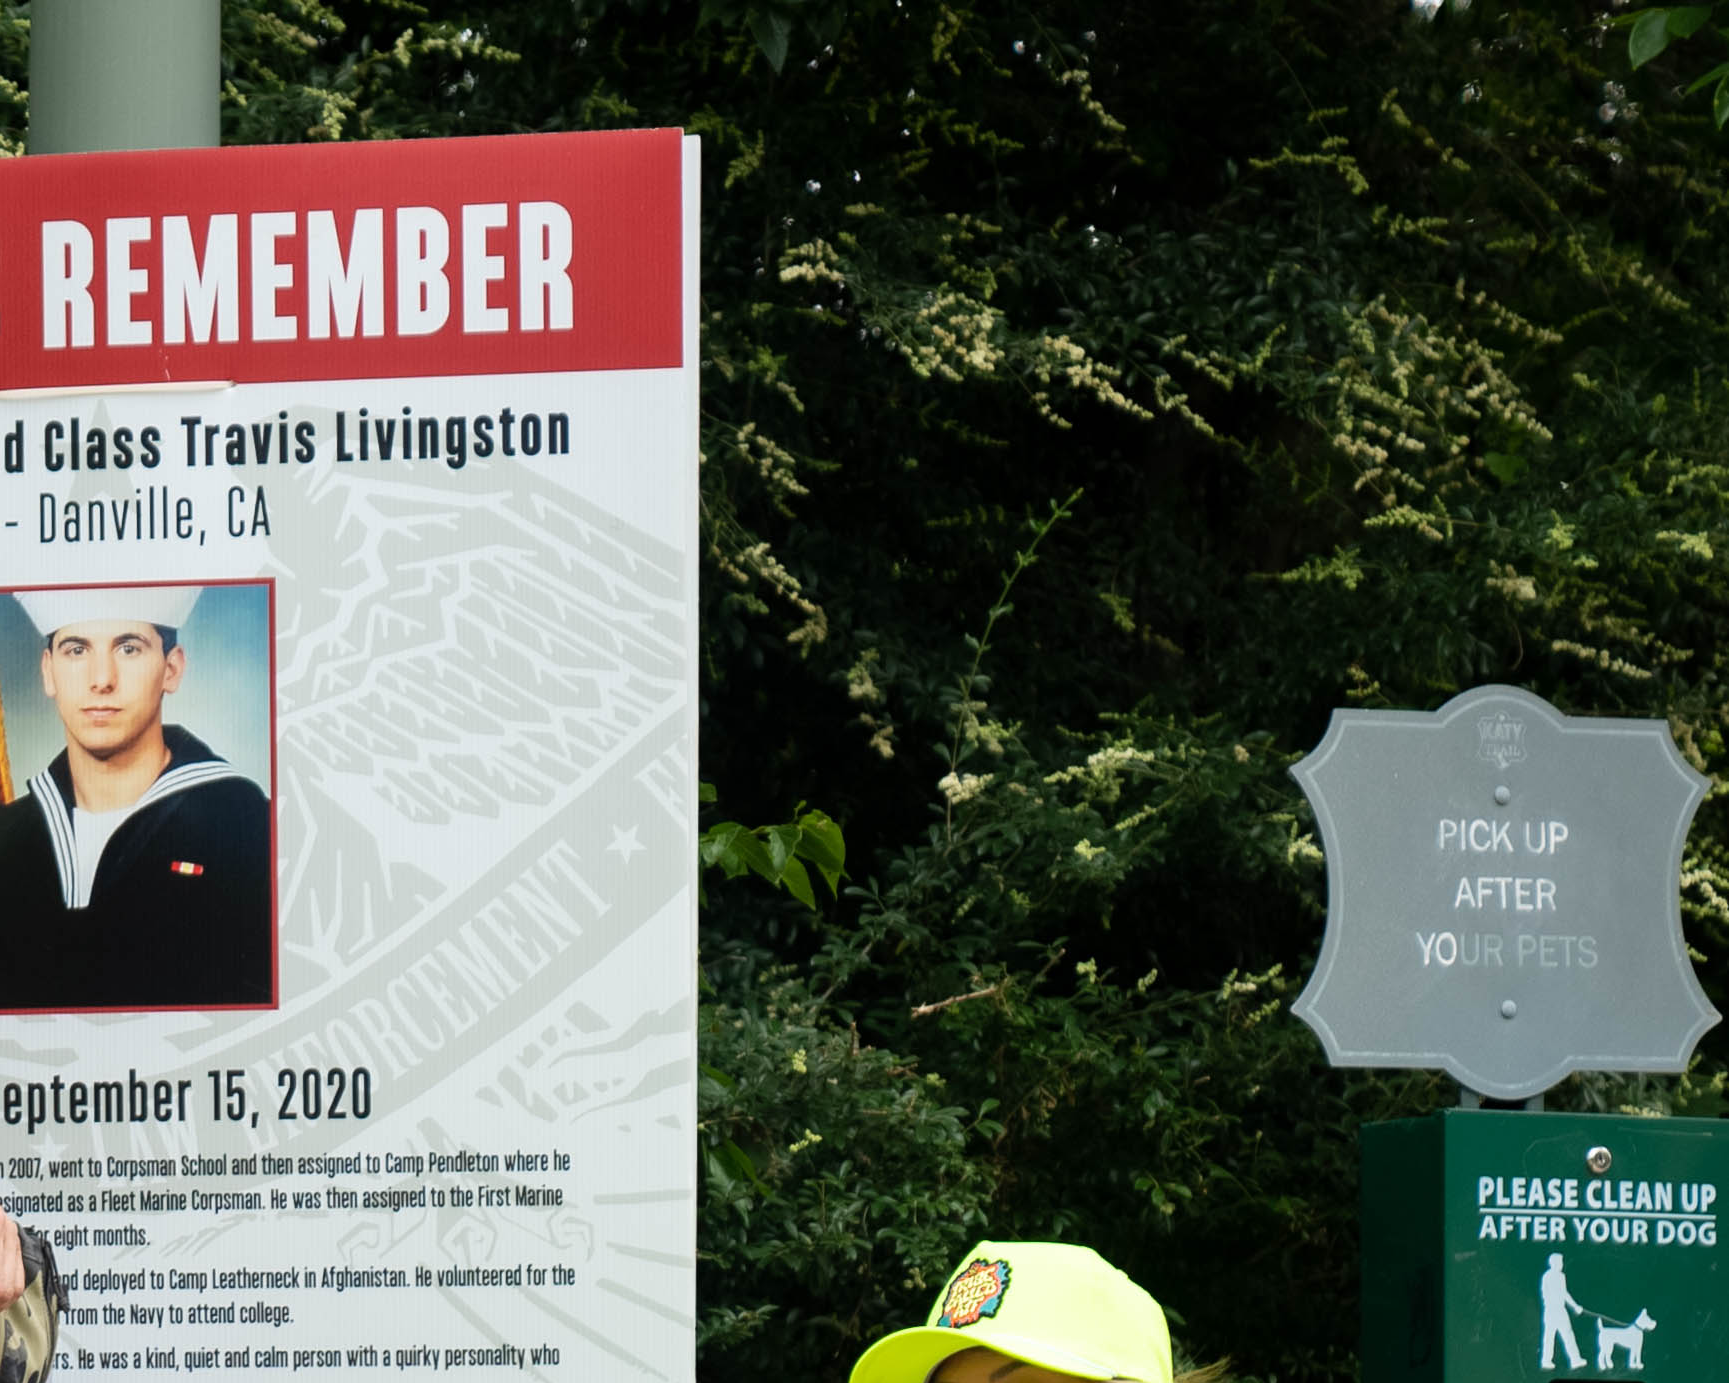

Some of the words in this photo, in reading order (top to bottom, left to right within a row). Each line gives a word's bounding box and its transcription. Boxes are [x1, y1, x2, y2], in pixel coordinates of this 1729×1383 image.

[43, 202, 573, 348] REMEMBER
[45, 419, 160, 471] Class
[181, 412, 314, 466] Travis
[337, 407, 568, 469] Livingston
[40, 487, 204, 545] Danville,
[229, 486, 270, 537] CA
[1437, 819, 1514, 853] PICK
[1525, 821, 1568, 855] UP
[1454, 877, 1556, 912] AFTER
[1416, 932, 1503, 968] YOUR
[1517, 935, 1599, 969] PETS
[208, 1070, 259, 1128] 15,
[279, 1068, 371, 1120] 2020
[9, 1158, 43, 1181] 2007,
[49, 1158, 83, 1178] went
[88, 1158, 101, 1177] to
[107, 1156, 176, 1181] Corpsman
[182, 1154, 226, 1176] School
[232, 1154, 256, 1175] and
[262, 1153, 293, 1175] then
[298, 1152, 361, 1178] assigned
[366, 1155, 380, 1173] to
[386, 1153, 423, 1177] Camp
[429, 1151, 498, 1172] Pendleton
[505, 1150, 548, 1171] where
[554, 1150, 570, 1171] he
[68, 1195, 84, 1212] as
[89, 1195, 96, 1212] a
[102, 1190, 135, 1211] Fleet
[140, 1190, 186, 1211] Marine
[192, 1190, 265, 1214] Corpsman.
[271, 1190, 287, 1209] He
[293, 1192, 321, 1208] was
[326, 1187, 357, 1208] then
[363, 1186, 425, 1212] assigned
[431, 1188, 445, 1207] to
[450, 1186, 473, 1207] the
[479, 1185, 510, 1206] First
[516, 1185, 562, 1206] Marine
[1478, 1176, 1580, 1211] PLEASE
[1585, 1180, 1674, 1212] CLEAN
[1680, 1182, 1717, 1213] UP
[54, 1225, 88, 1250] eight
[94, 1224, 150, 1246] months.
[1479, 1215, 1567, 1242] AFTER
[1572, 1216, 1649, 1244] YOUR
[1656, 1217, 1717, 1246] DOG
[84, 1269, 145, 1294] deployed
[150, 1271, 164, 1289] to
[170, 1269, 207, 1293] Camp
[213, 1267, 299, 1289] Leatherneck
[305, 1268, 316, 1288] in
[322, 1267, 409, 1292] Afghanistan.
[416, 1267, 431, 1287] He
[438, 1265, 521, 1286] volunteered
[527, 1264, 546, 1285] for
[552, 1264, 575, 1285] the
[103, 1303, 125, 1324] the
[131, 1305, 163, 1328] Navy
[169, 1305, 183, 1324] to
[189, 1302, 234, 1323] attend
[240, 1302, 293, 1327] college.
[79, 1349, 94, 1369] He
[100, 1352, 128, 1369] was
[134, 1352, 141, 1368] a
[147, 1347, 179, 1371] kind,
[185, 1348, 220, 1372] quiet
[225, 1347, 249, 1368] and
[255, 1346, 288, 1368] calm
[294, 1351, 341, 1371] person
[347, 1346, 377, 1366] with
[383, 1350, 390, 1366] a
[396, 1345, 439, 1370] quirky
[445, 1344, 525, 1370] personality
[531, 1344, 559, 1365] who
